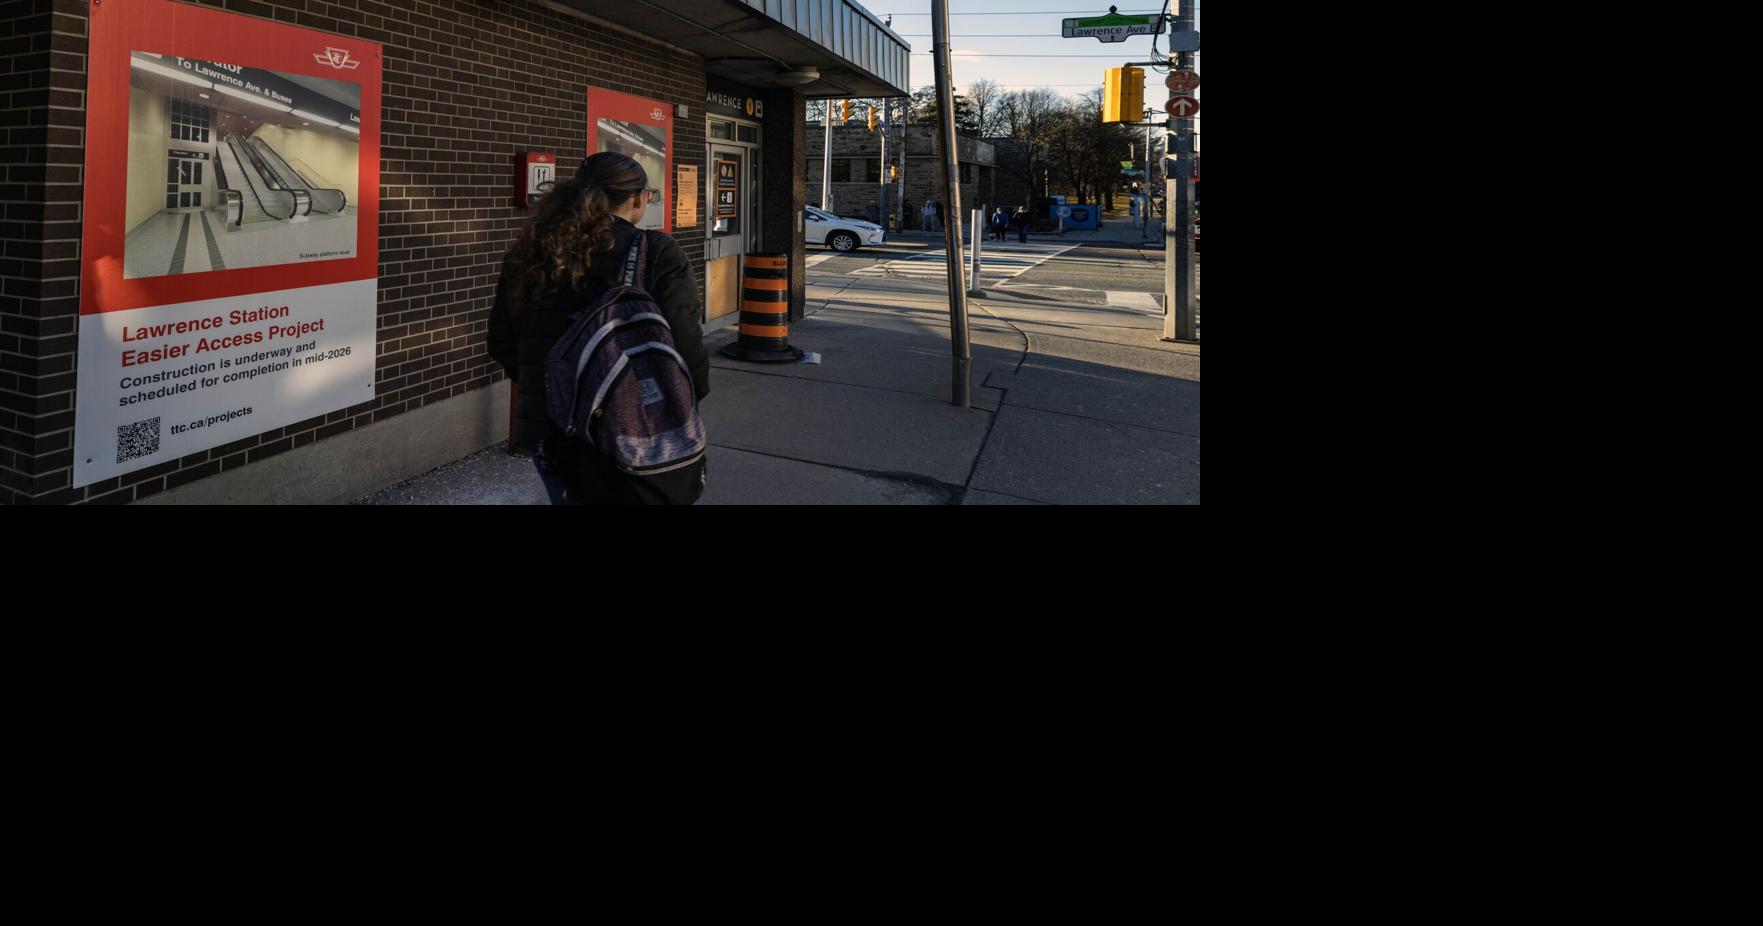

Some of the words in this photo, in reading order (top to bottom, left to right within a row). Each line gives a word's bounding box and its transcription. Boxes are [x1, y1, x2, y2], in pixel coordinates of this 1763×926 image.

[1072, 26, 1122, 36] Lawrence
[1126, 25, 1146, 34] Ave
[175, 56, 192, 69] To
[195, 62, 244, 87] Lawrence
[245, 81, 262, 94] Ave.
[271, 90, 293, 104] Buses
[207, 60, 243, 74] ator
[121, 343, 190, 368] Easier
[196, 330, 263, 354] Access
[269, 318, 324, 341] Project
[122, 314, 223, 343] Lawrence
[229, 305, 289, 326] Station
[119, 379, 196, 407] scheduled
[200, 376, 220, 389] for
[223, 360, 289, 384] completion
[292, 357, 302, 368] in
[304, 346, 351, 364] mid-2026
[120, 361, 215, 390] Construction
[220, 357, 231, 370] is
[235, 347, 292, 366] underway
[295, 340, 316, 354] and
[170, 406, 253, 435] ttc.ca/projects
